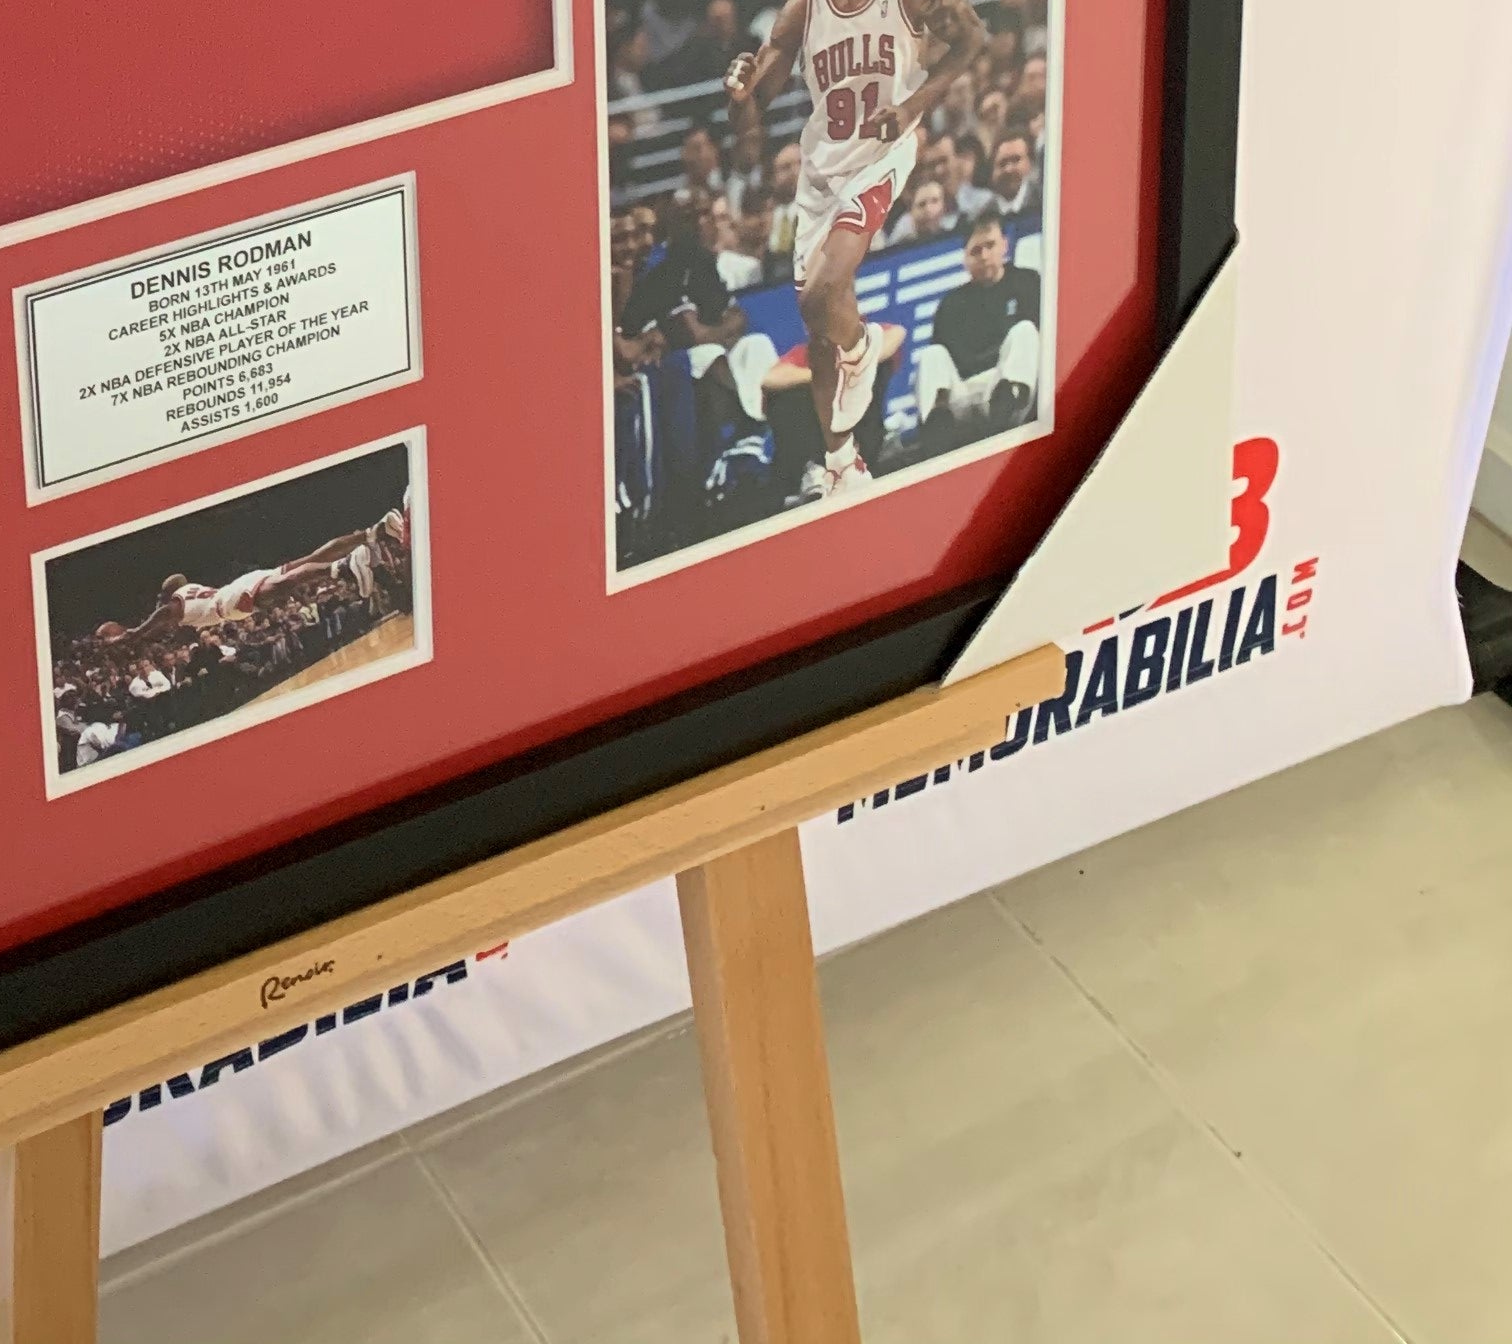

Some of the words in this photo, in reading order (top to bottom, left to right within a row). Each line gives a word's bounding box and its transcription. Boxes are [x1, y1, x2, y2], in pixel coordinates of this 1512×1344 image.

[813, 33, 896, 93] BULLS
[131, 261, 211, 300] DENNIS
[218, 231, 313, 274] RODMAN
[149, 290, 190, 312] BORN
[195, 279, 229, 298] 13TH
[232, 268, 262, 287] MAY
[266, 258, 296, 277] 1961
[108, 313, 168, 341] CAREER
[173, 286, 259, 322] HIGHLIGHTS
[263, 282, 273, 294] &
[276, 262, 337, 290] AWARDS
[159, 327, 176, 342] 5X
[180, 317, 210, 336] NBA
[214, 292, 290, 325] CHAMPION
[79, 384, 97, 400] 2X
[100, 374, 131, 393] NBA
[135, 347, 215, 382] DEFENSIVE
[219, 330, 274, 356] PLAYER
[278, 322, 296, 338] OF
[300, 312, 328, 330] THE
[331, 300, 369, 321] YEAR
[164, 342, 181, 357] 2X
[185, 332, 215, 350] NBA
[219, 310, 287, 340] ALL-STAR
[111, 391, 129, 406] 7X
[132, 380, 163, 399] NBA
[167, 349, 262, 389] REBOUNDING
[266, 324, 341, 357] CHAMPION
[183, 374, 235, 400] POINTS
[238, 362, 273, 383] 6,683
[166, 387, 246, 421] REBOUNDS
[250, 372, 291, 393] 11,954
[180, 405, 241, 433] ASSISTS
[244, 392, 279, 413] 1,600
